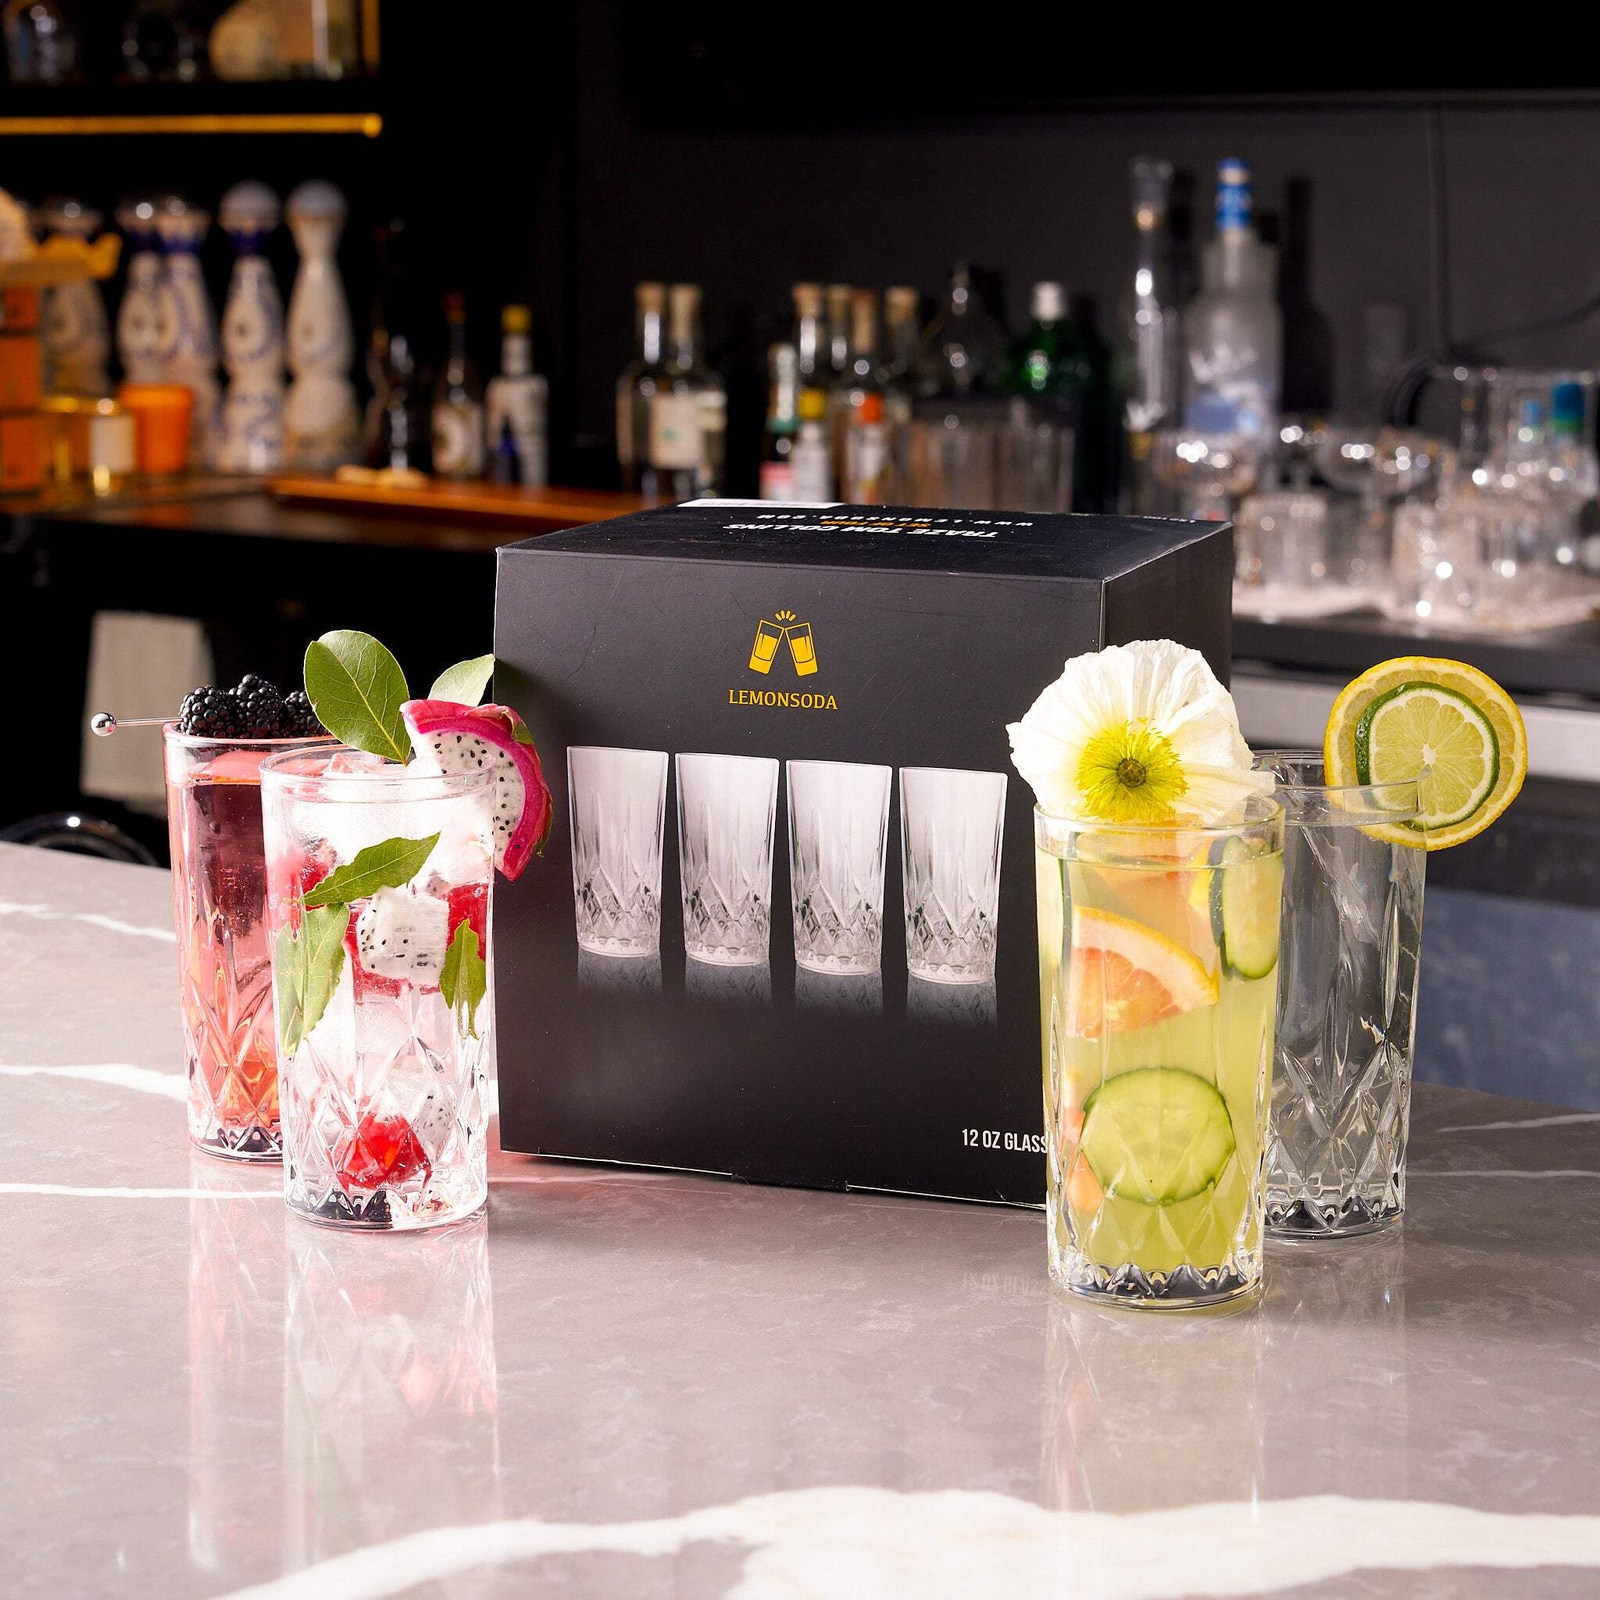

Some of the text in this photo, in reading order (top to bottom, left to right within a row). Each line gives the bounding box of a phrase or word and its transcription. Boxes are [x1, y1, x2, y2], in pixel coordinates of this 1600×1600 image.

[906, 528, 998, 538] TRAZE
[728, 689, 839, 710] LEMONSODA
[961, 1128, 979, 1147] 12
[982, 1130, 1001, 1149] OZ
